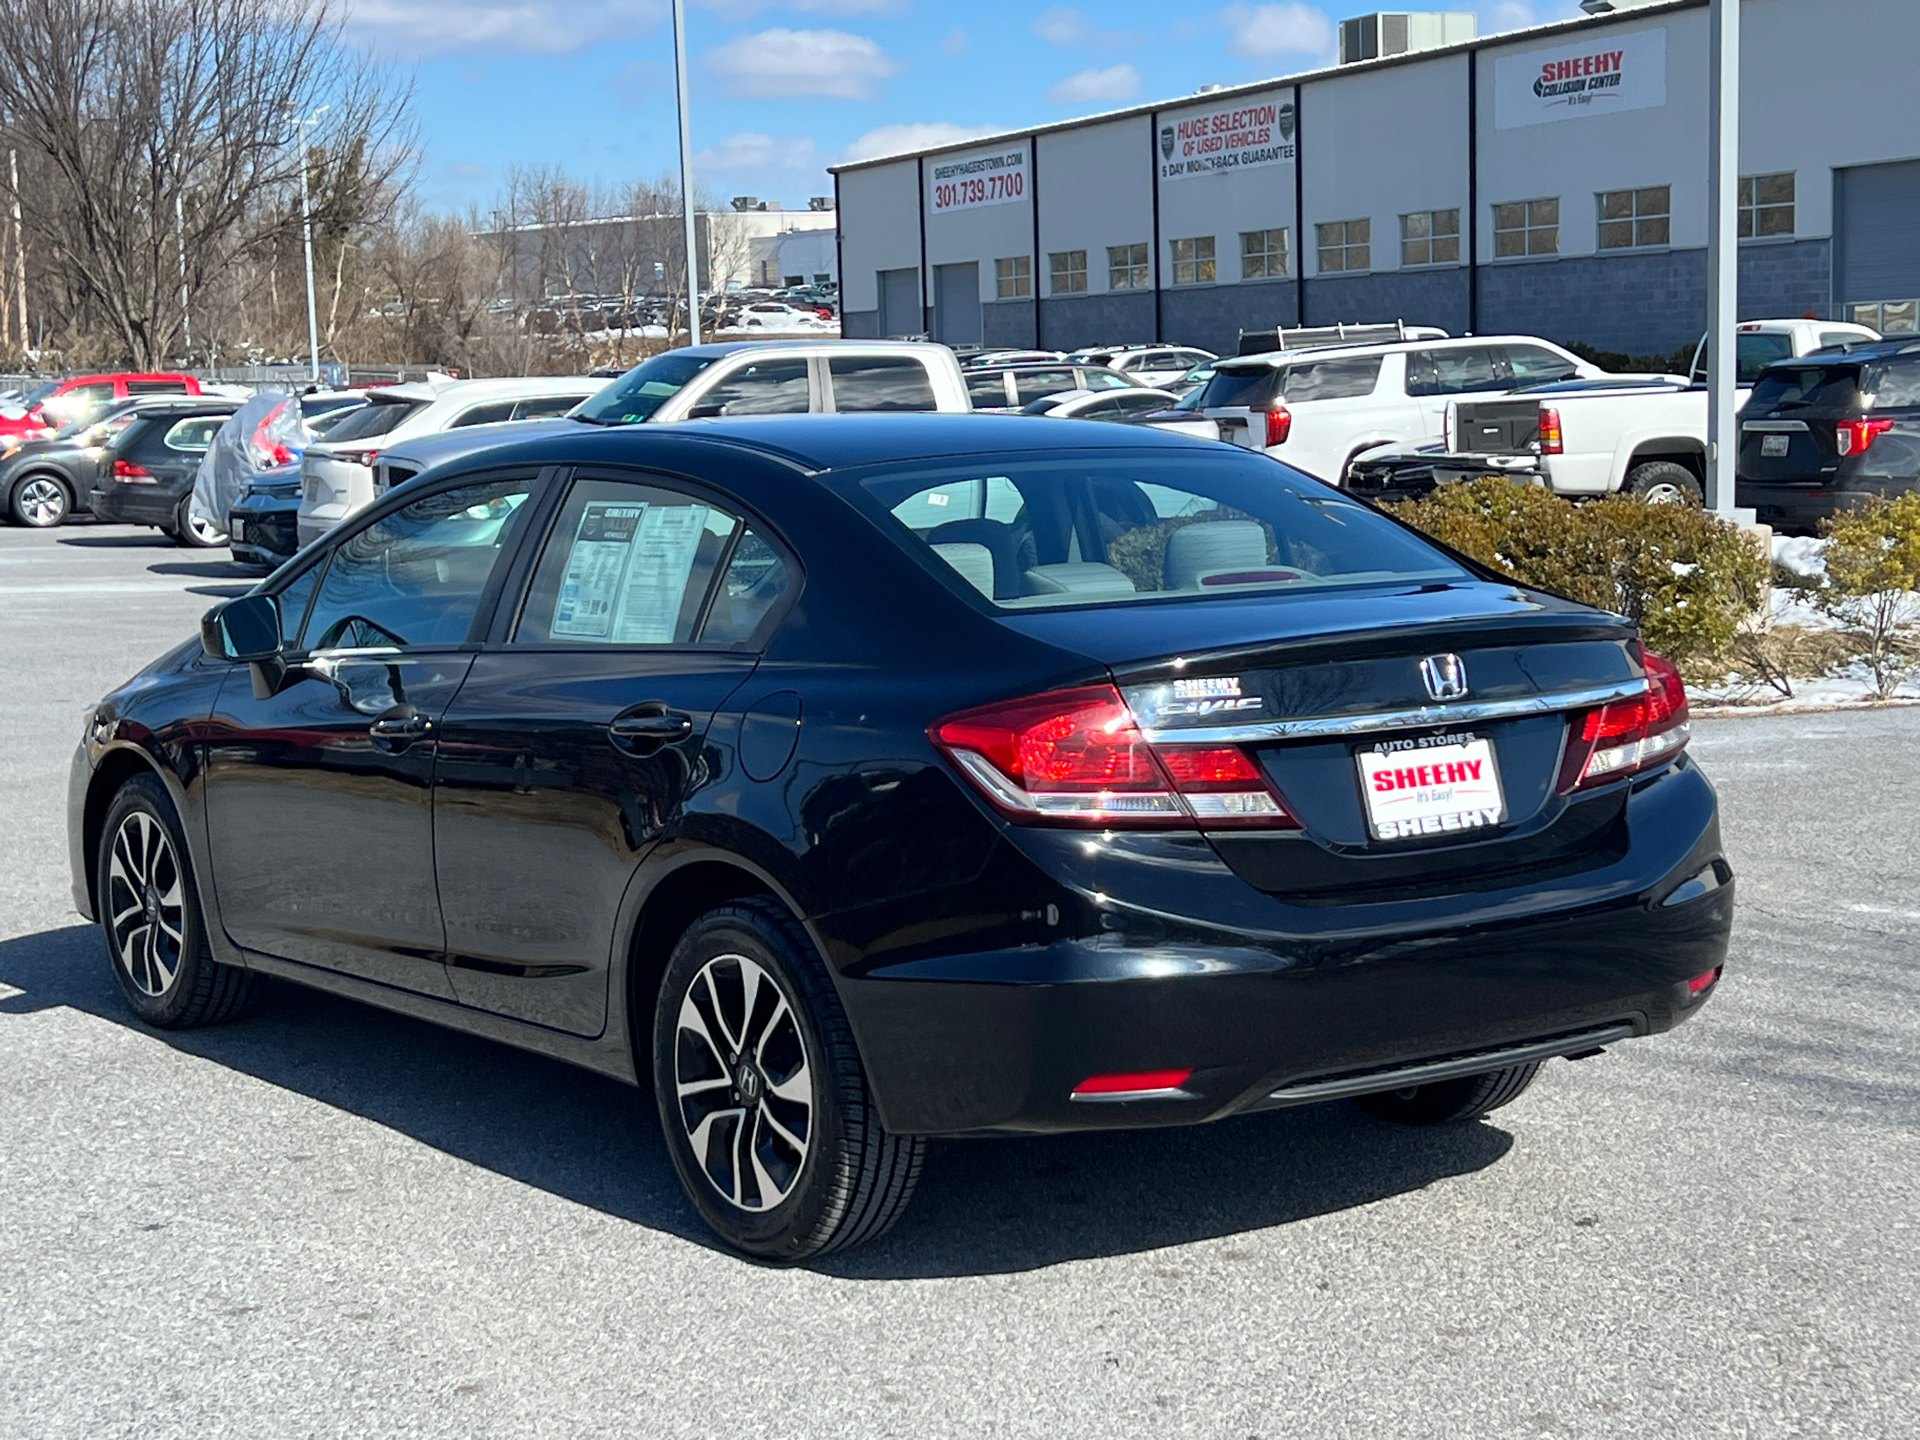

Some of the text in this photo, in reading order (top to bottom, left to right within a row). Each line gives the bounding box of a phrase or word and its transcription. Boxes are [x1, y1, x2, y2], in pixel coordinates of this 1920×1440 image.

[1542, 50, 1624, 82] SHEEHY
[1543, 72, 1621, 97] COLLISION CENTER
[1568, 94, 1577, 105] It's
[1177, 117, 1209, 140] HUGE
[1211, 105, 1276, 133] SELECTION
[1183, 140, 1195, 157] OF
[1197, 136, 1223, 154] USED
[1225, 127, 1271, 148] VEHICLES
[935, 152, 1023, 180] SHEEHYHAGERSTOWN.COM
[1162, 144, 1294, 177] 5 DAY MOY-BACK GUARANTEE
[935, 171, 1023, 208] 301.739.7700
[602, 518, 638, 530] VALUE
[604, 508, 641, 518] SHEEHY
[603, 531, 628, 539] VEHICLE
[1173, 677, 1239, 690] SHEEHY
[1156, 697, 1263, 716] CIVIC
[1373, 732, 1476, 754] AUTO STORES
[1372, 759, 1482, 792] SHEEHY
[1417, 787, 1453, 804] It's Easy!
[1377, 807, 1502, 839] SHEEHY
